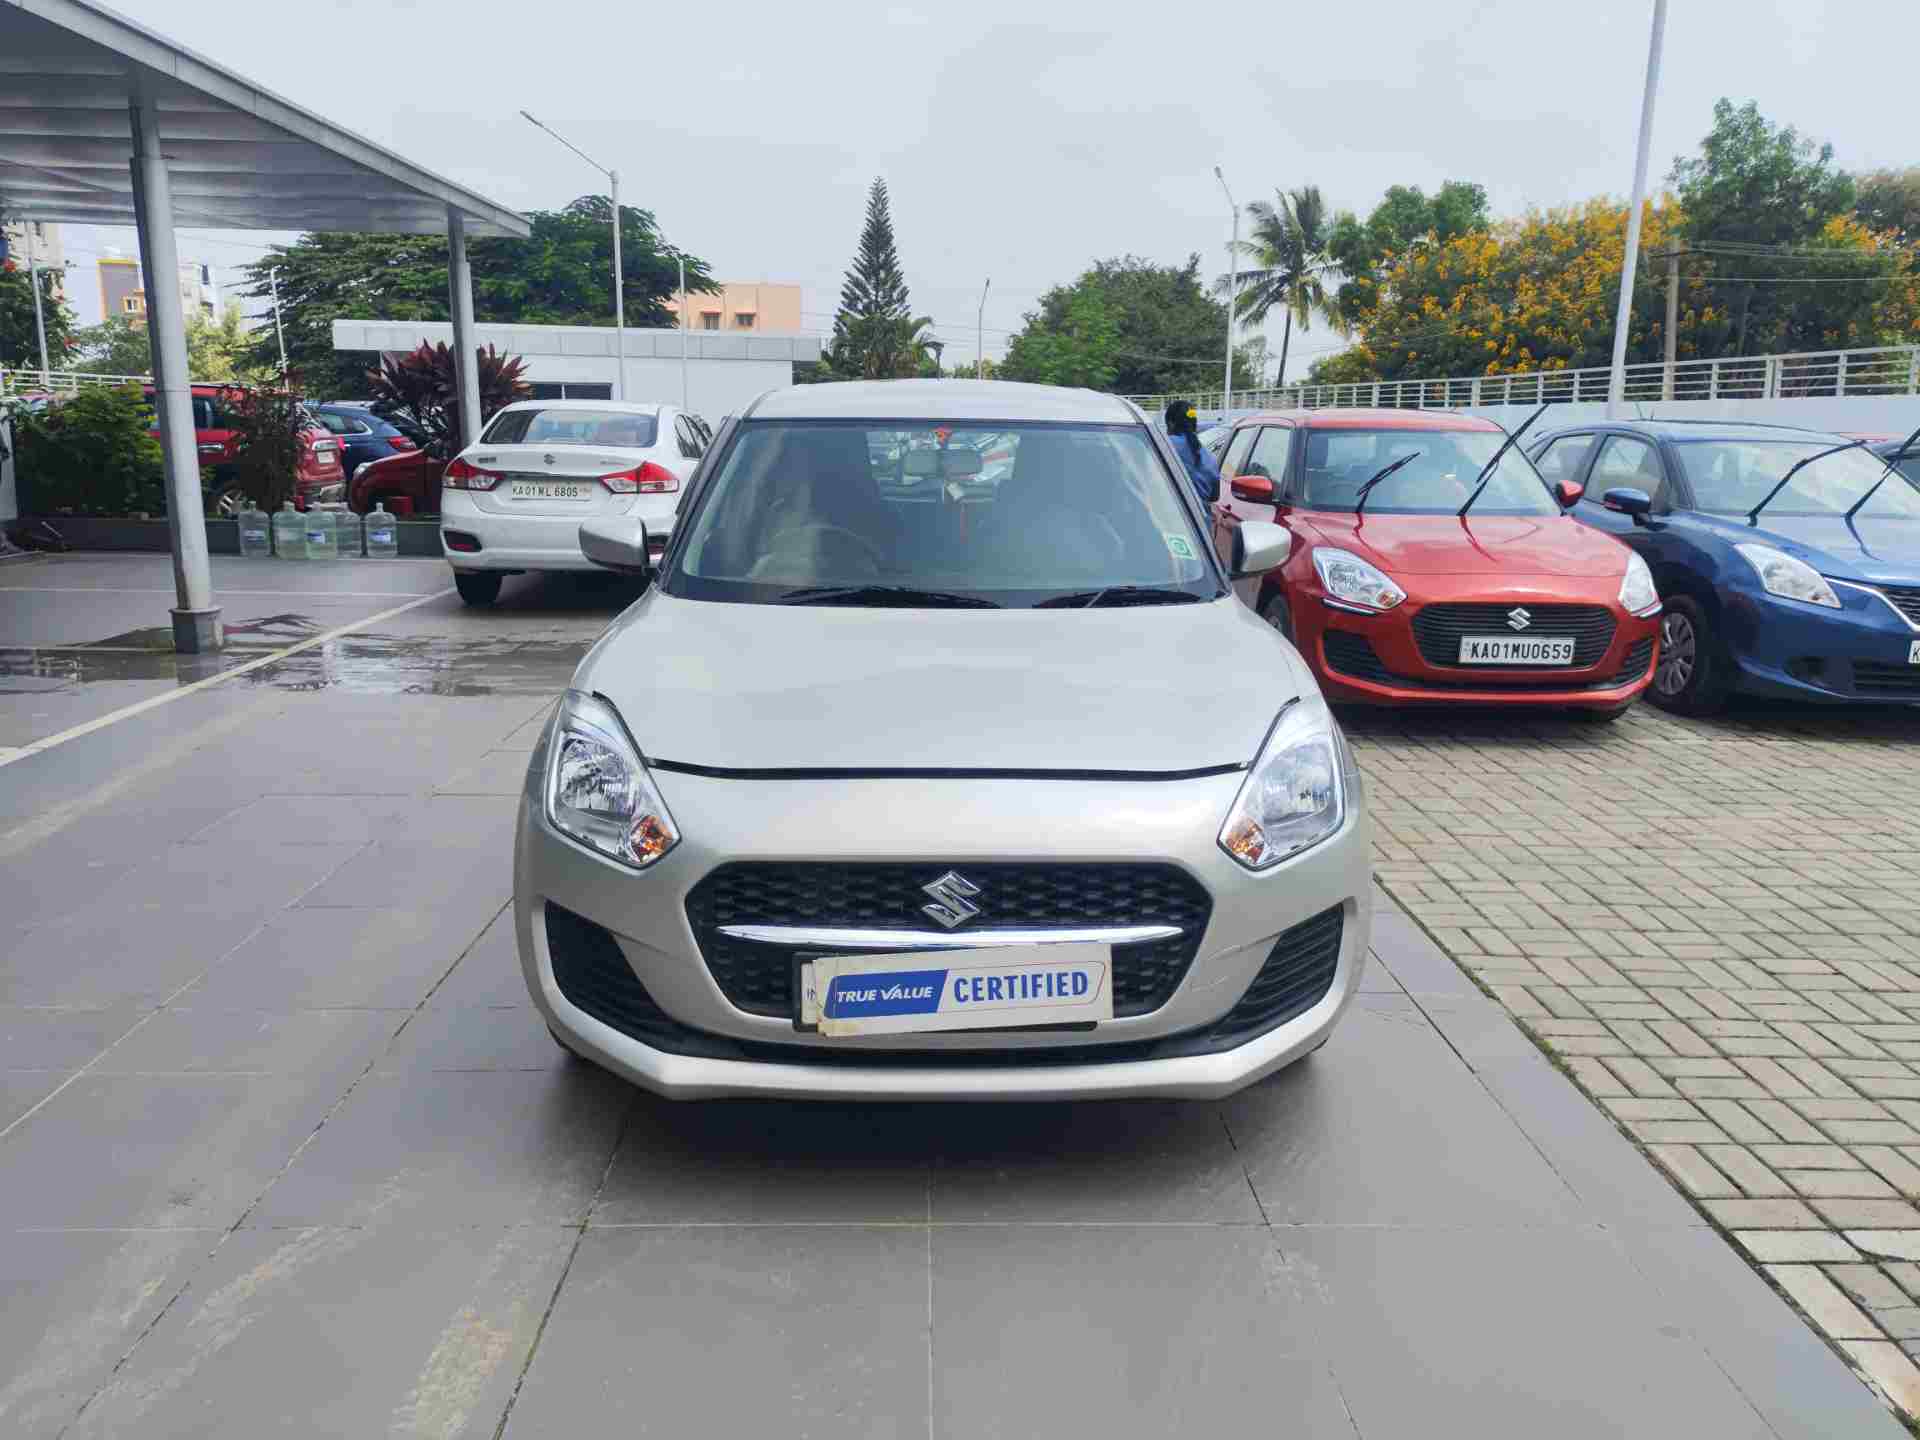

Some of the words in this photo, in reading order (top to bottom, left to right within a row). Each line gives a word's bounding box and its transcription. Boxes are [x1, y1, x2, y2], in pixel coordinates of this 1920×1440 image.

[1471, 642, 1572, 660] KA01MU0659
[837, 989, 877, 1002] TRUE
[880, 984, 933, 1000] VALUE
[954, 971, 1088, 1002] CERTIFIED
